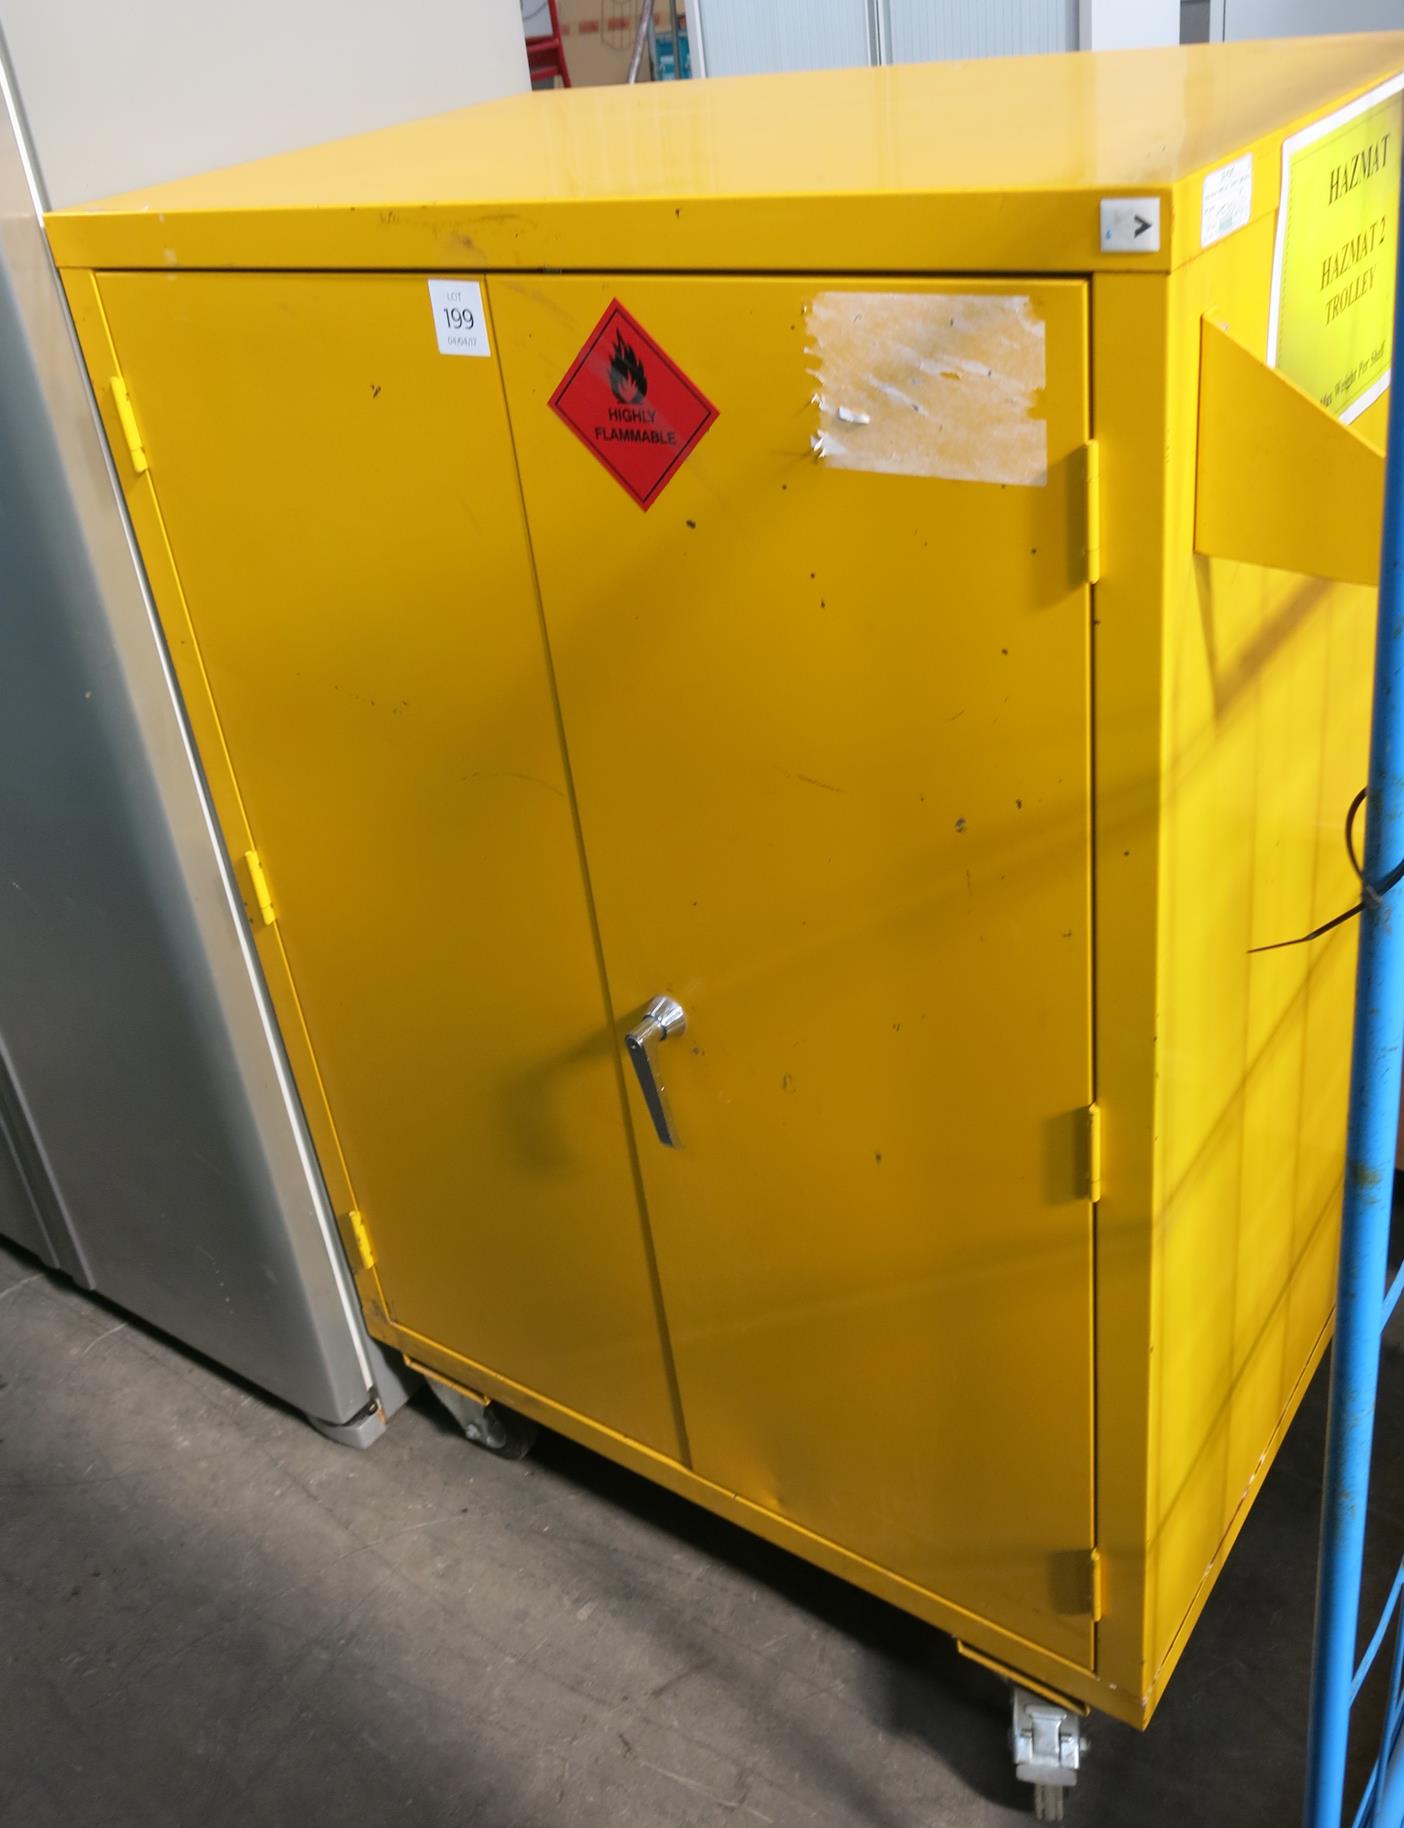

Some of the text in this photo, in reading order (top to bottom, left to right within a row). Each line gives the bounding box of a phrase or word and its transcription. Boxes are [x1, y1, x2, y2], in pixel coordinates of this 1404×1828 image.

[1328, 132, 1391, 206] HAZMAT
[1320, 214, 1386, 292] HAZMAT 2
[446, 291, 462, 302] LOT
[1325, 263, 1376, 327] TROLLEY
[443, 307, 475, 330] 199
[1357, 358, 1370, 380] Per
[608, 408, 656, 424] HIGHLY
[594, 426, 678, 445] FLAMMABLE
